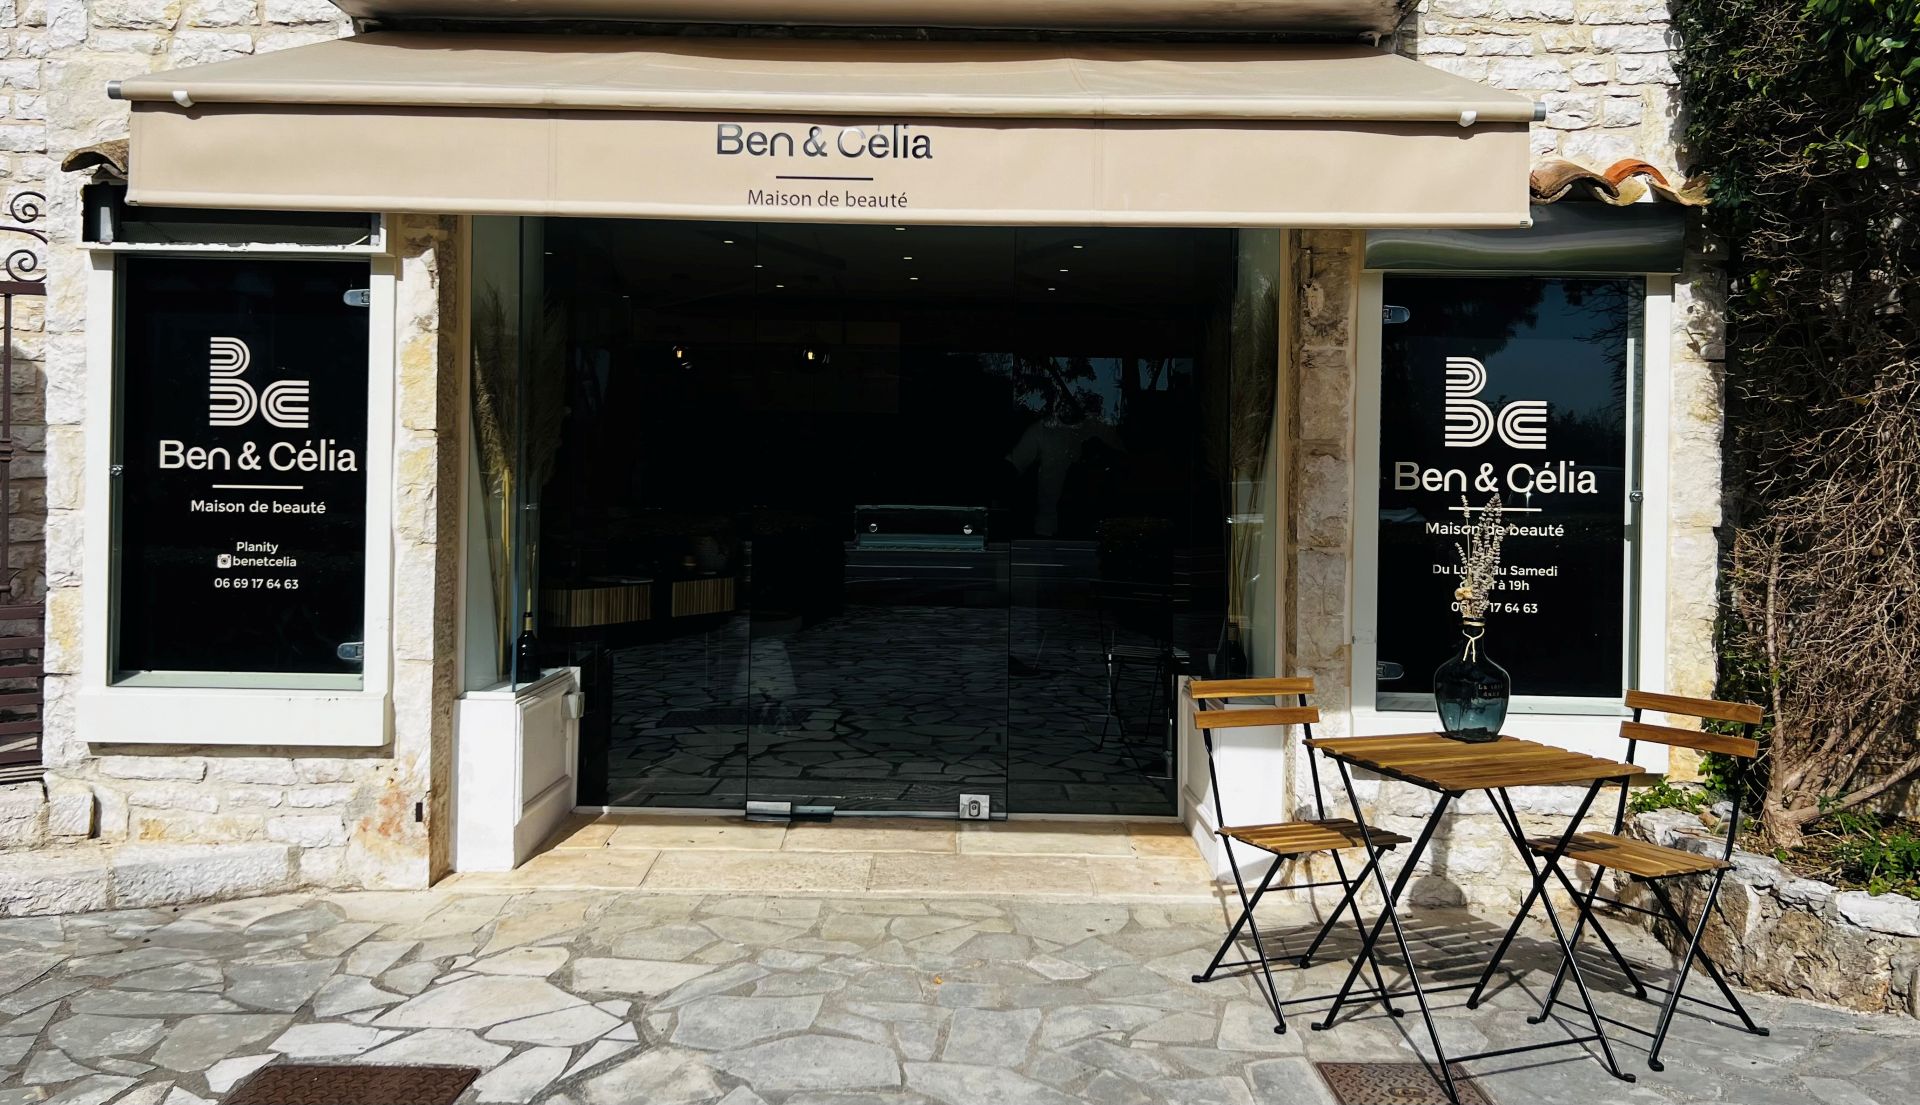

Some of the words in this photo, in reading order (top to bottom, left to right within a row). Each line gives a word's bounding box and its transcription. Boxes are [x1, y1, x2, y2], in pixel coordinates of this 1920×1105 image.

[717, 123, 794, 157] Ben
[802, 125, 828, 158] &
[837, 122, 933, 159] Célia
[748, 190, 812, 207] Maison
[817, 190, 840, 208] de
[845, 191, 908, 209] beauté
[159, 439, 231, 471] Ben
[237, 441, 262, 471] &
[268, 438, 358, 472] Célia
[1394, 461, 1467, 492] Ben
[1474, 462, 1499, 493] &
[1506, 460, 1599, 494] Célia
[190, 499, 245, 513] Maison
[249, 500, 269, 514] de
[272, 500, 327, 514] beauté
[1425, 522, 1480, 535] Maison
[1487, 522, 1505, 536] de
[1509, 523, 1565, 537] beauté
[236, 541, 279, 555] Planity
[232, 555, 297, 567] benetcelia
[1432, 564, 1450, 575] Du
[1510, 565, 1558, 577] Samedi
[214, 577, 231, 589] 06
[233, 577, 249, 589] 69
[251, 578, 264, 589] 17
[266, 578, 281, 590] 64
[284, 579, 299, 590] 63
[1498, 580, 1506, 590] à
[1508, 580, 1530, 591] 19h
[1490, 603, 1502, 613] 17
[1504, 603, 1520, 613] 64
[1523, 603, 1538, 614] 63
